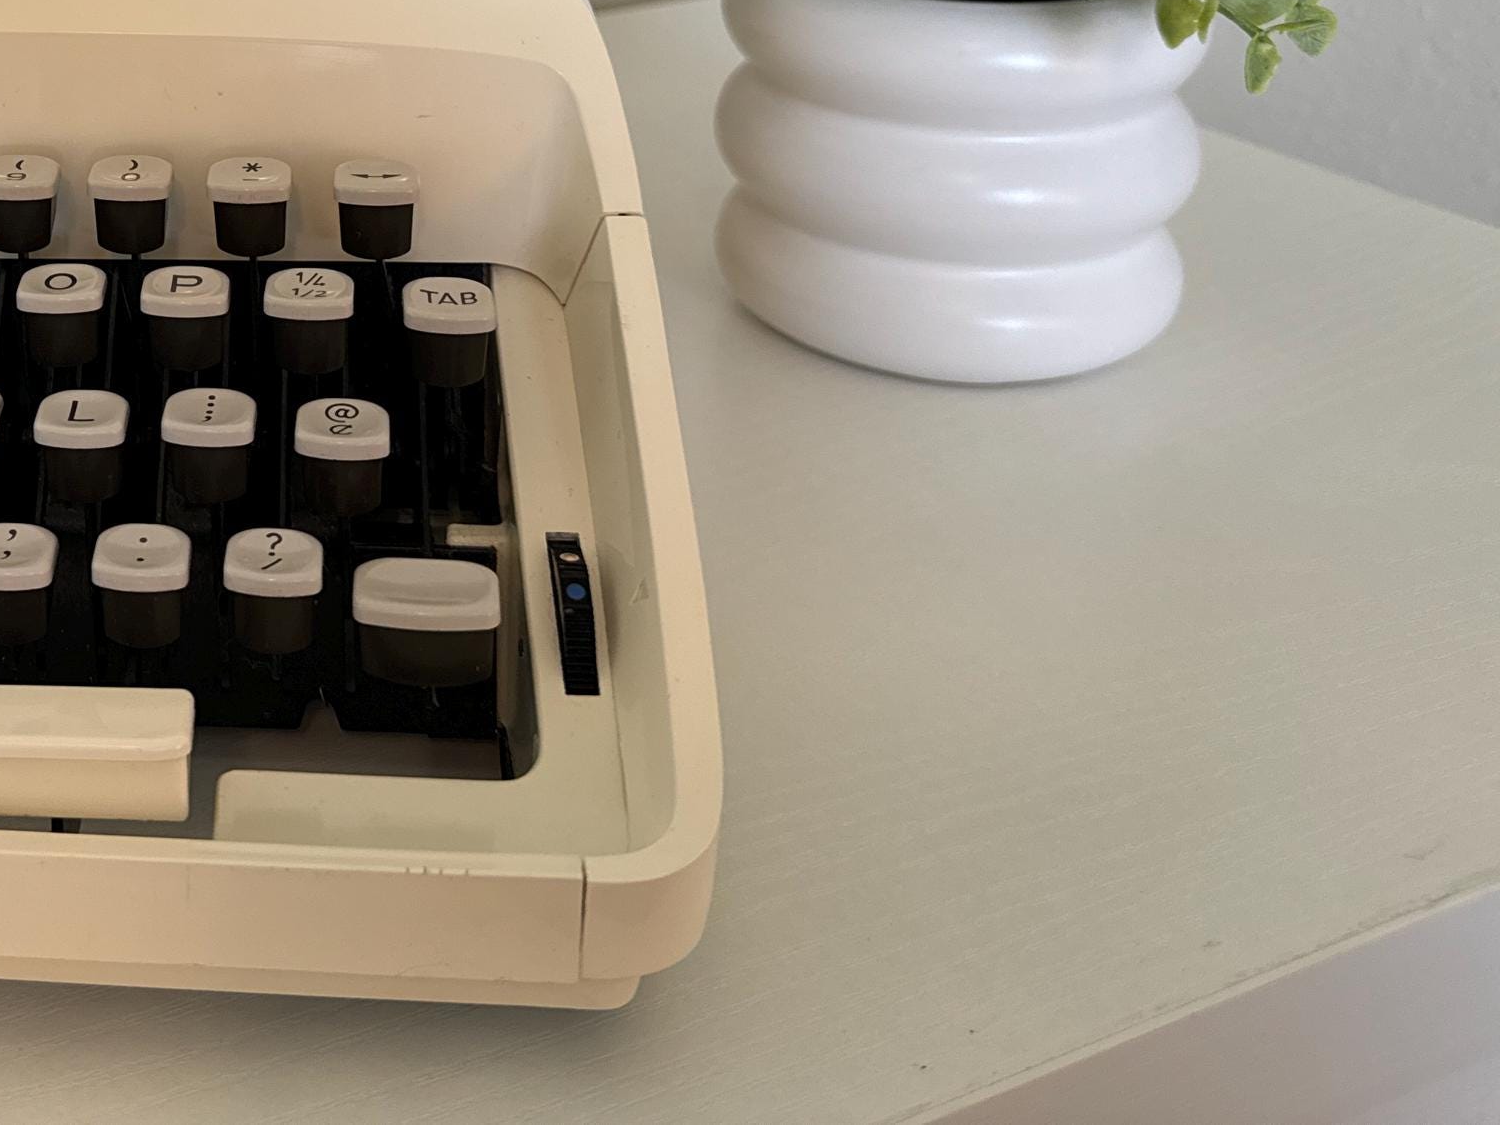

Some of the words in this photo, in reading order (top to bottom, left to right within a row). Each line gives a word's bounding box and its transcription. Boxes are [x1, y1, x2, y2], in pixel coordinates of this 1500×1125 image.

[44, 272, 78, 291] O
[169, 274, 204, 293] P
[419, 288, 478, 306] TAB
[67, 400, 95, 422] L
[324, 402, 360, 424] @
[265, 532, 283, 557] ?
